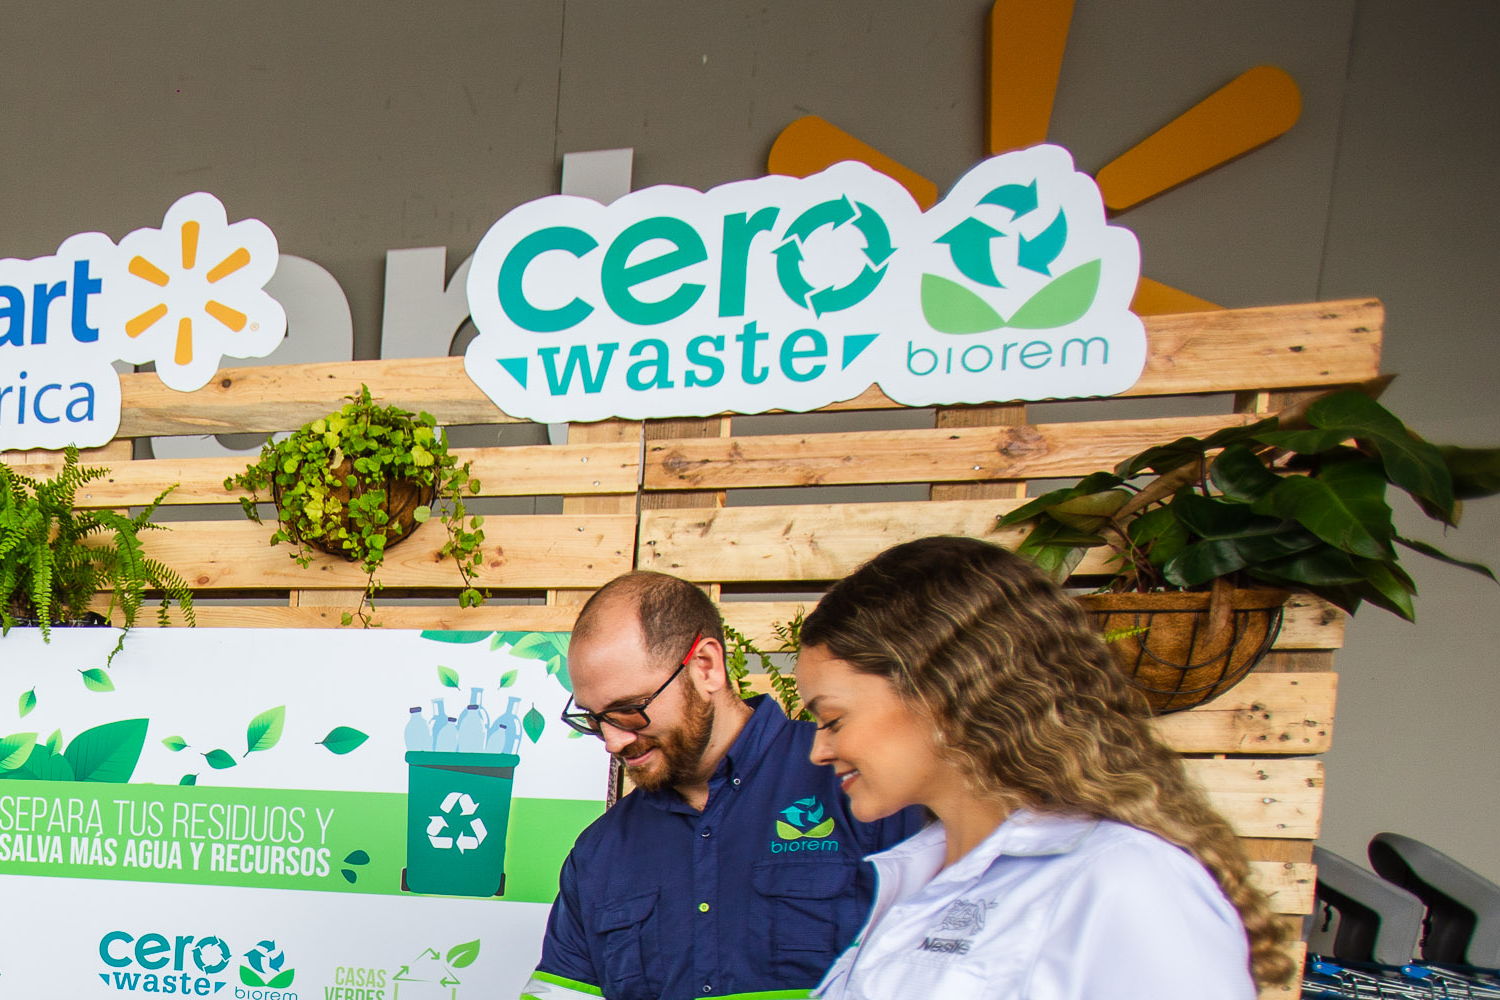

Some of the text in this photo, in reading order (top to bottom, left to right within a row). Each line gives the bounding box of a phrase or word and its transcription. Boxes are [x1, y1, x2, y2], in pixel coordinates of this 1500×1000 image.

[498, 193, 897, 334] cero
[538, 326, 829, 397] waste
[907, 335, 1110, 377] biorem
[113, 800, 164, 837] TUS
[173, 802, 306, 844] RESIDUOS
[314, 808, 335, 845] Y
[70, 832, 117, 868] MÁS
[123, 841, 183, 870] AGUA
[190, 843, 204, 871] Y
[211, 844, 330, 878] RECURSOS
[771, 840, 839, 853] biorem
[99, 931, 231, 976] cero
[112, 971, 211, 997] waste
[335, 966, 387, 990] CASAS
